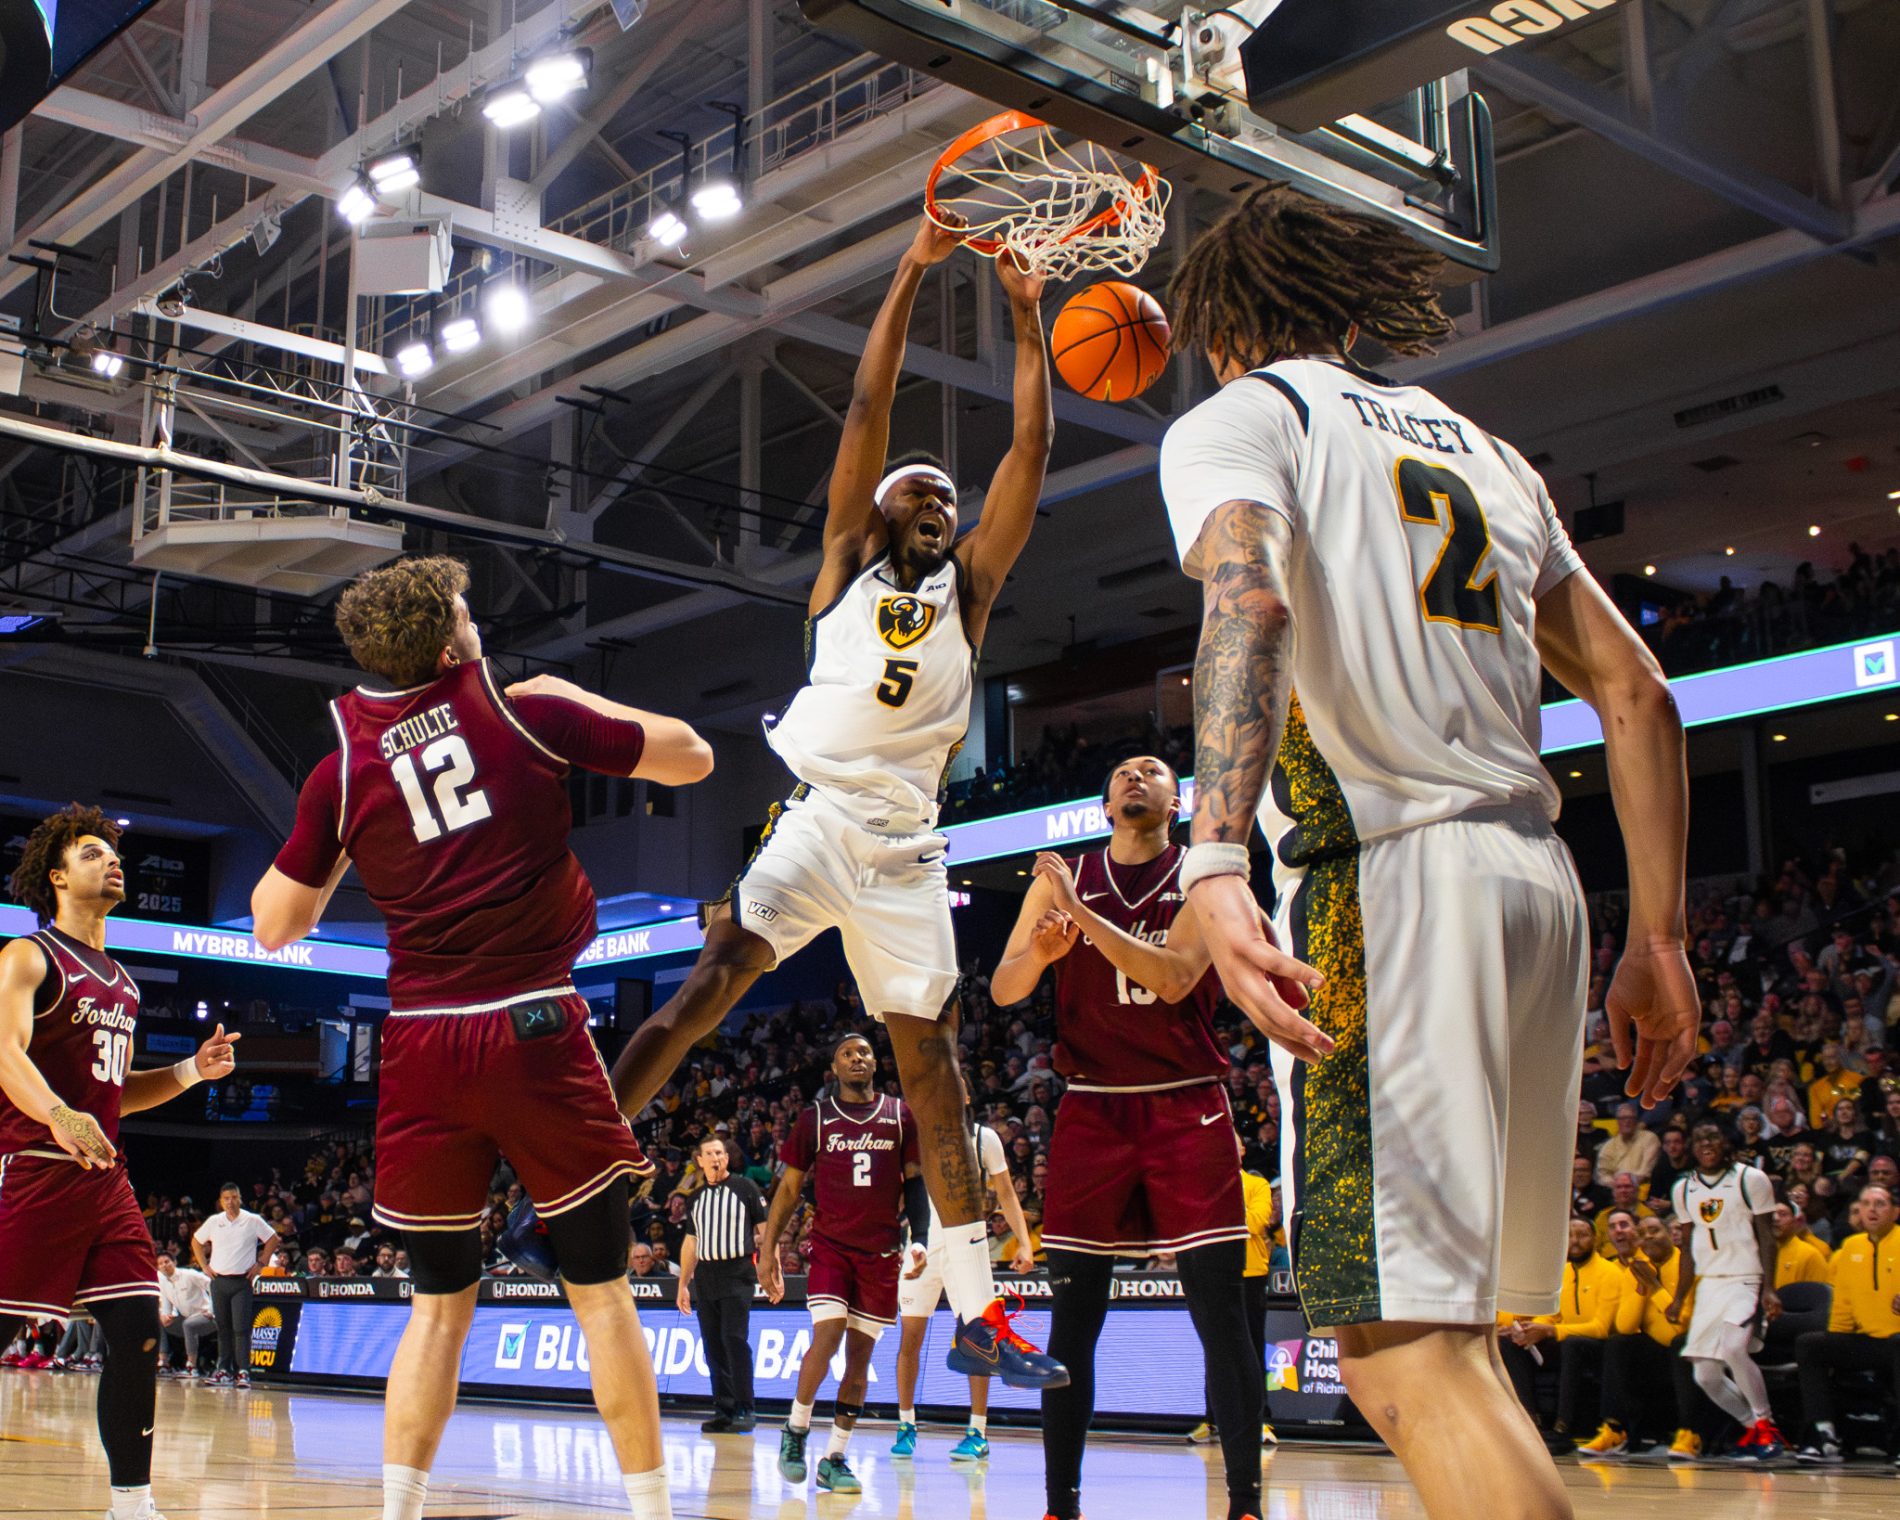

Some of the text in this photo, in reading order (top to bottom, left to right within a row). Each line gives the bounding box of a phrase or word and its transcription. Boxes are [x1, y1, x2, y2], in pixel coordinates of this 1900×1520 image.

[1341, 392, 1474, 454] TRACEY
[1394, 455, 1501, 634] 2
[876, 656, 920, 709] 5
[381, 703, 459, 759] SCHULTE
[391, 734, 493, 844] 12
[138, 892, 182, 912] 2025
[748, 901, 778, 921] VCU
[607, 931, 651, 958] BANK
[91, 1029, 128, 1087] 30
[826, 1132, 895, 1153] Fordham
[853, 1152, 872, 1187] 2
[1707, 1228, 1719, 1250] 1
[261, 1281, 301, 1294] HONDA
[330, 1283, 375, 1296] HONDA
[505, 1283, 561, 1297] HONDA
[251, 1327, 282, 1340] MASSEY
[254, 1350, 276, 1366] VCU
[1301, 1381, 1314, 1394] of
